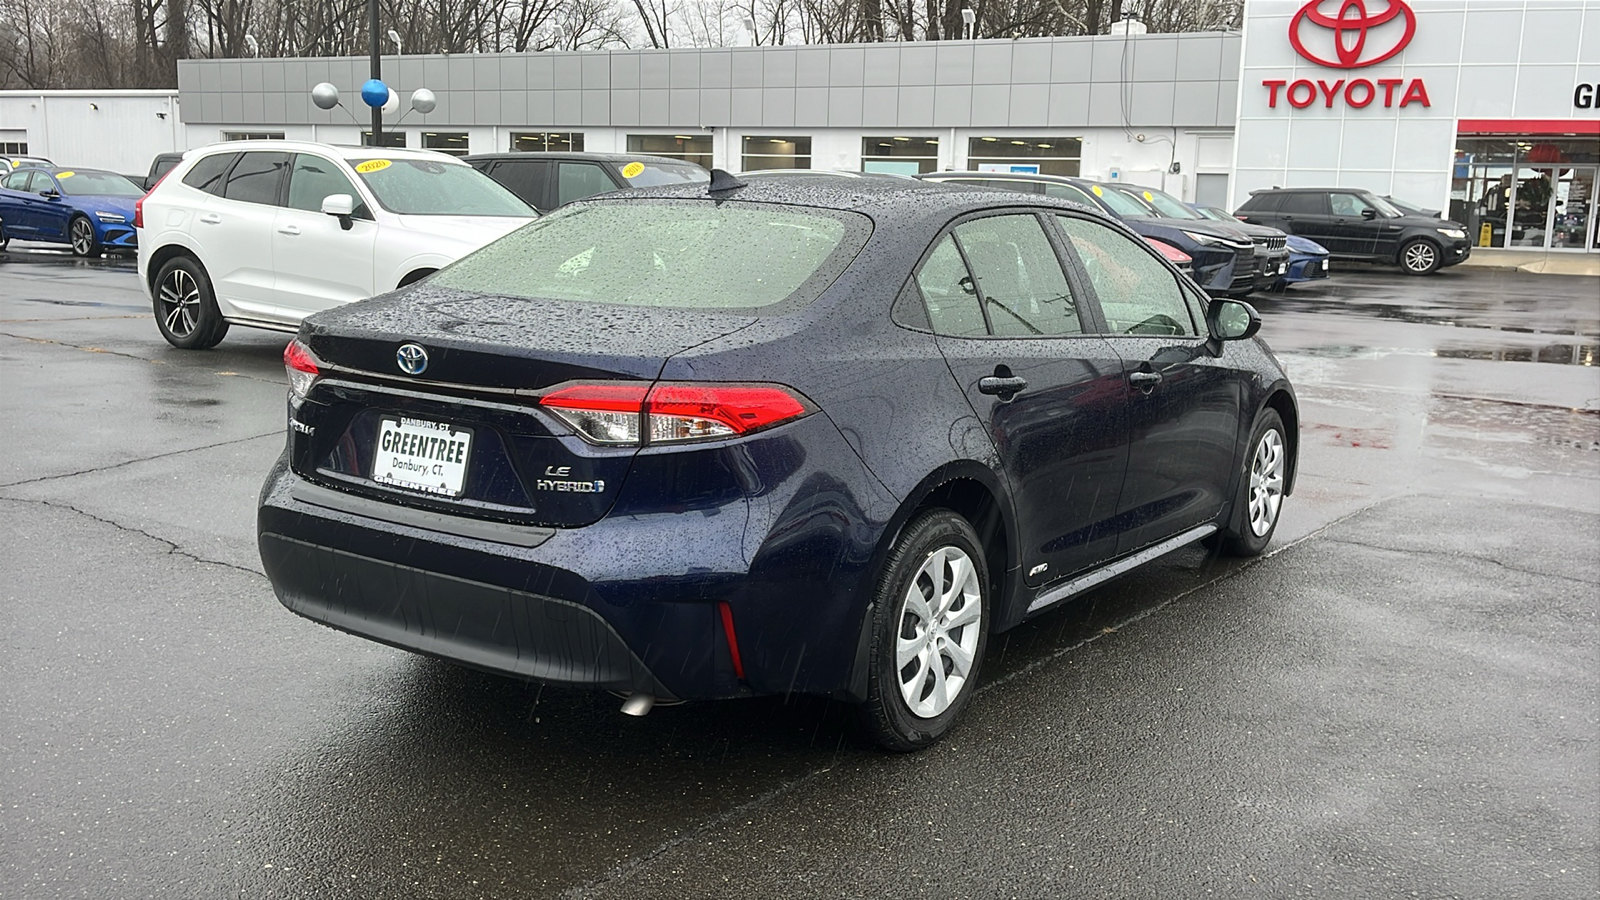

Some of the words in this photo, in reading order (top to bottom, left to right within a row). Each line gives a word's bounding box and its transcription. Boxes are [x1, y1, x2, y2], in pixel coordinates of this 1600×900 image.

[1262, 79, 1431, 109] TOYOTA
[1574, 83, 1600, 109] G
[361, 160, 386, 172] 2020
[382, 430, 465, 464] GREENTREE
[392, 457, 429, 476] Danbury,
[431, 463, 444, 477] CT.
[544, 465, 571, 477] LE
[373, 475, 456, 496] GREENTREE
[537, 479, 594, 493] HYBRID
